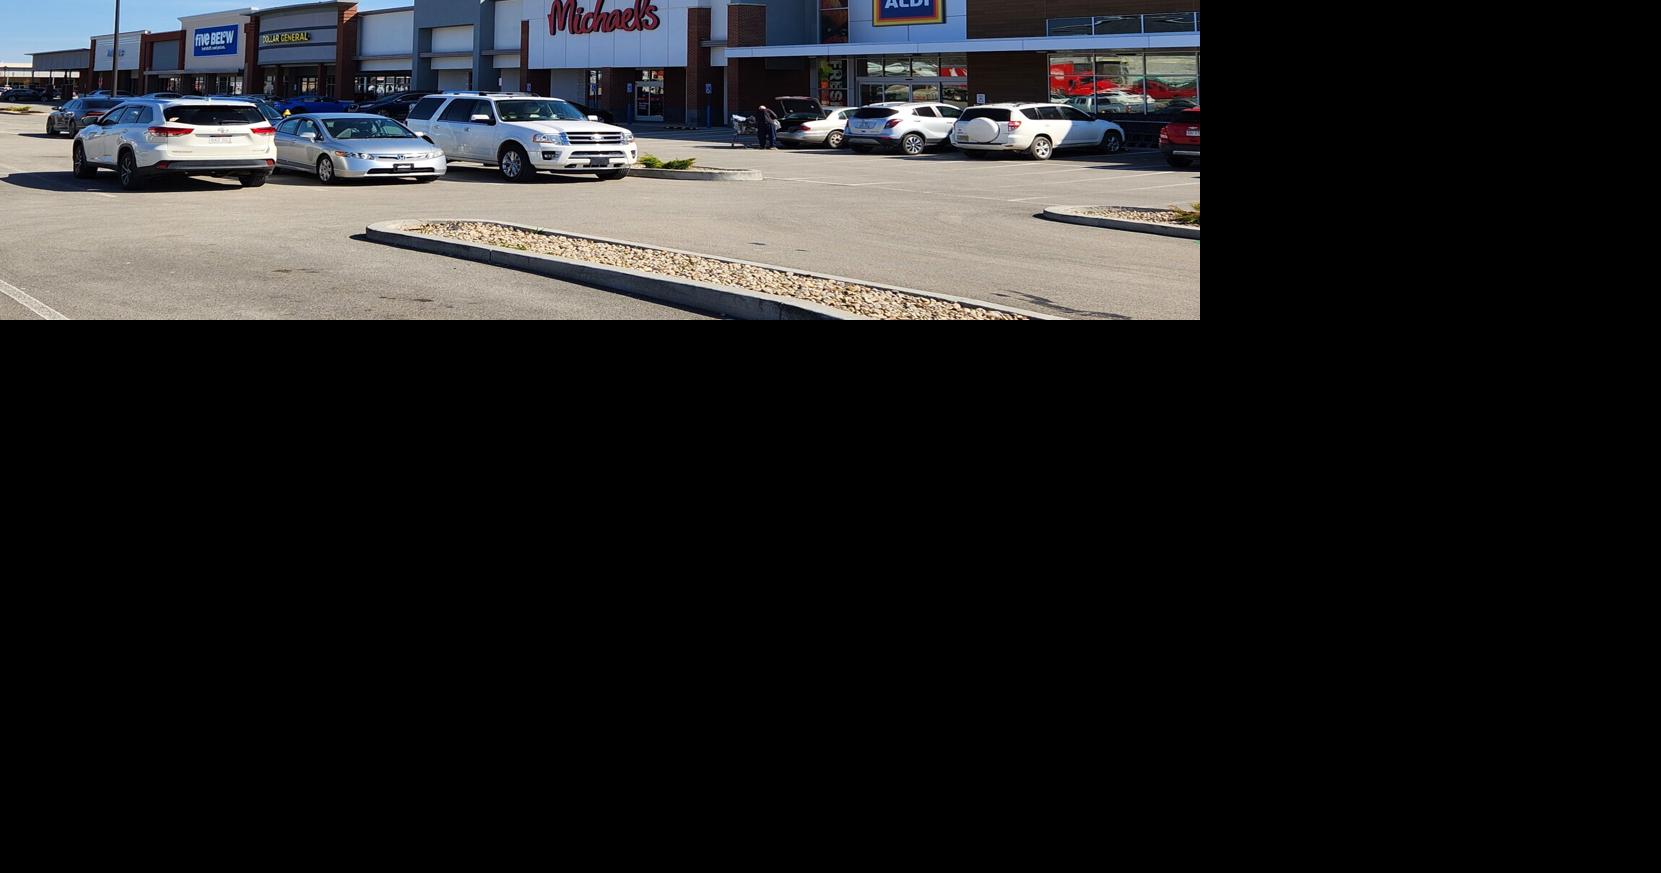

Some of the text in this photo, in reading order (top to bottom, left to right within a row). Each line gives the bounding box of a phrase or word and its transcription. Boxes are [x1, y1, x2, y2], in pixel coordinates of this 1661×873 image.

[547, 0, 660, 36] Michaels
[263, 31, 309, 44] DOLLAR GENERAL
